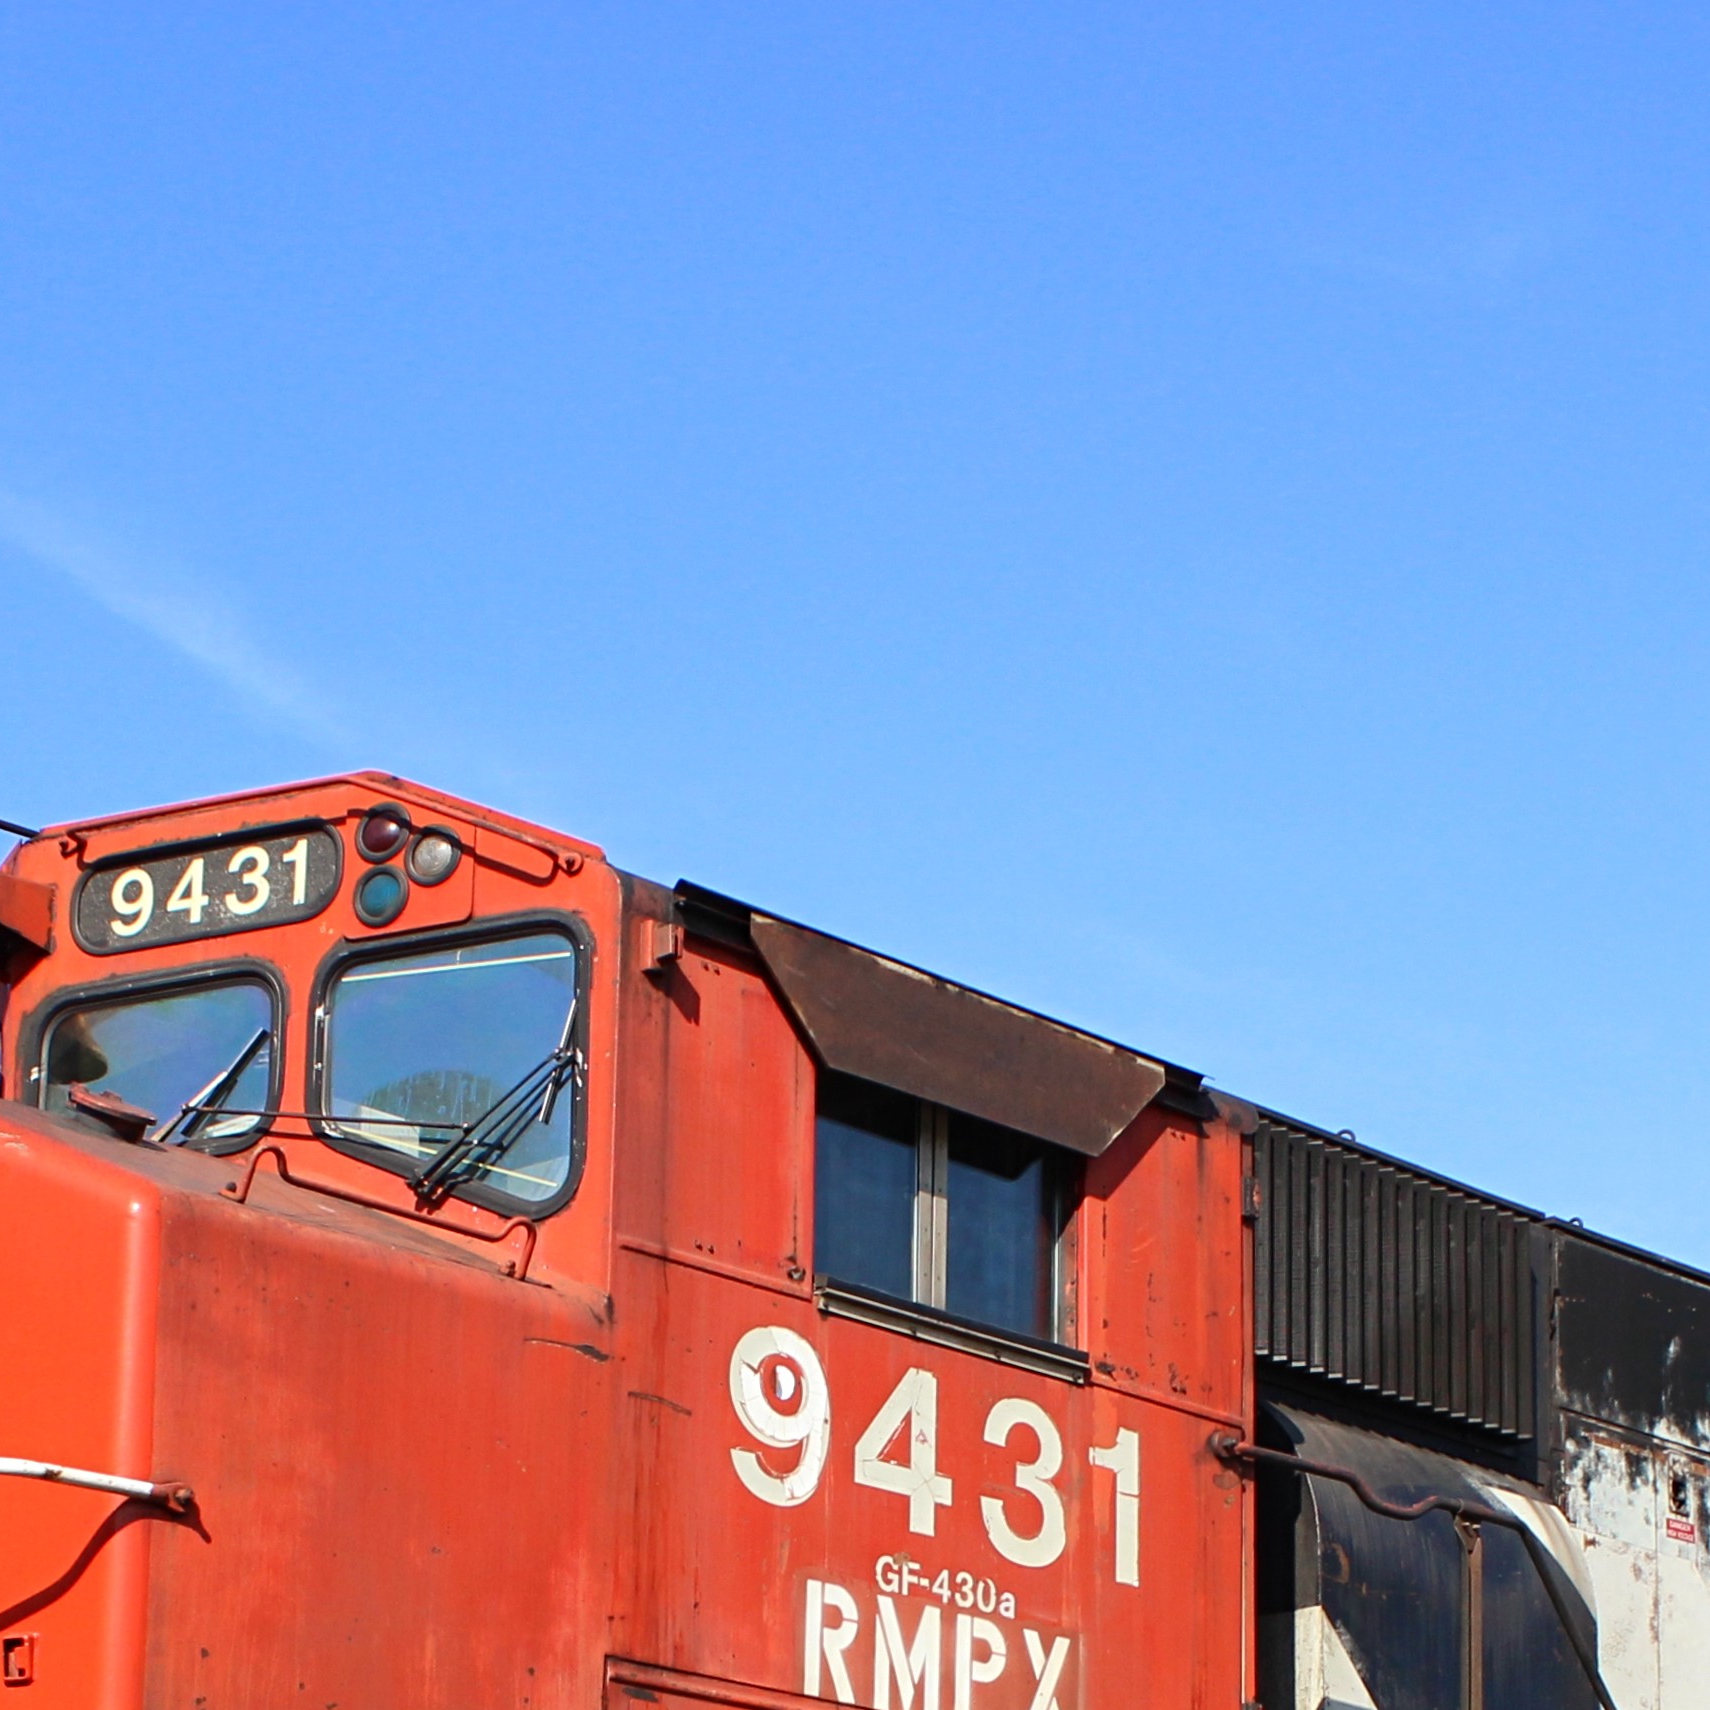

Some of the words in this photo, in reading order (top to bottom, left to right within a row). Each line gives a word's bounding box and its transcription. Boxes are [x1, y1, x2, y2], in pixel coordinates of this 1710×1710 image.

[110, 838, 309, 937] 9431
[728, 1325, 1142, 1588] 9431
[874, 1555, 1017, 1620] GF-430a
